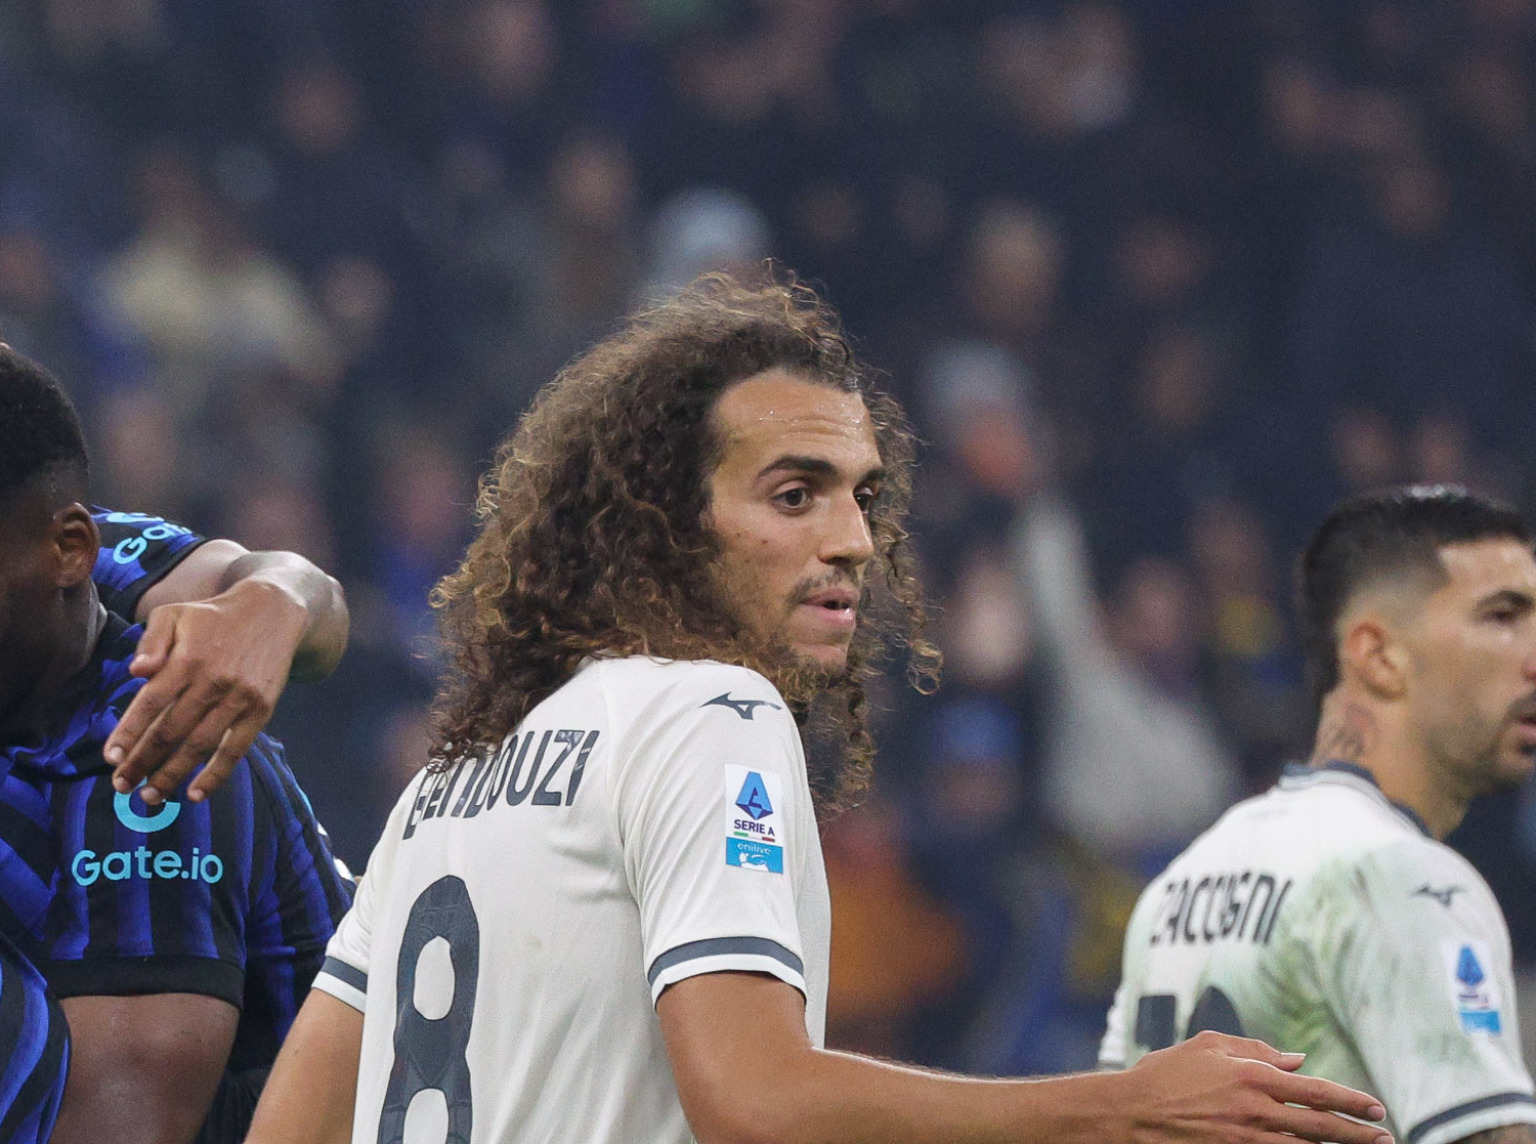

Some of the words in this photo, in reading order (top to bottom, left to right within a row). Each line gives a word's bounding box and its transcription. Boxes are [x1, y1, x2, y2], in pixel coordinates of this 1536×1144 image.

[734, 819, 766, 834] SERIE
[768, 826, 775, 836] A
[71, 844, 224, 887] Gate.io
